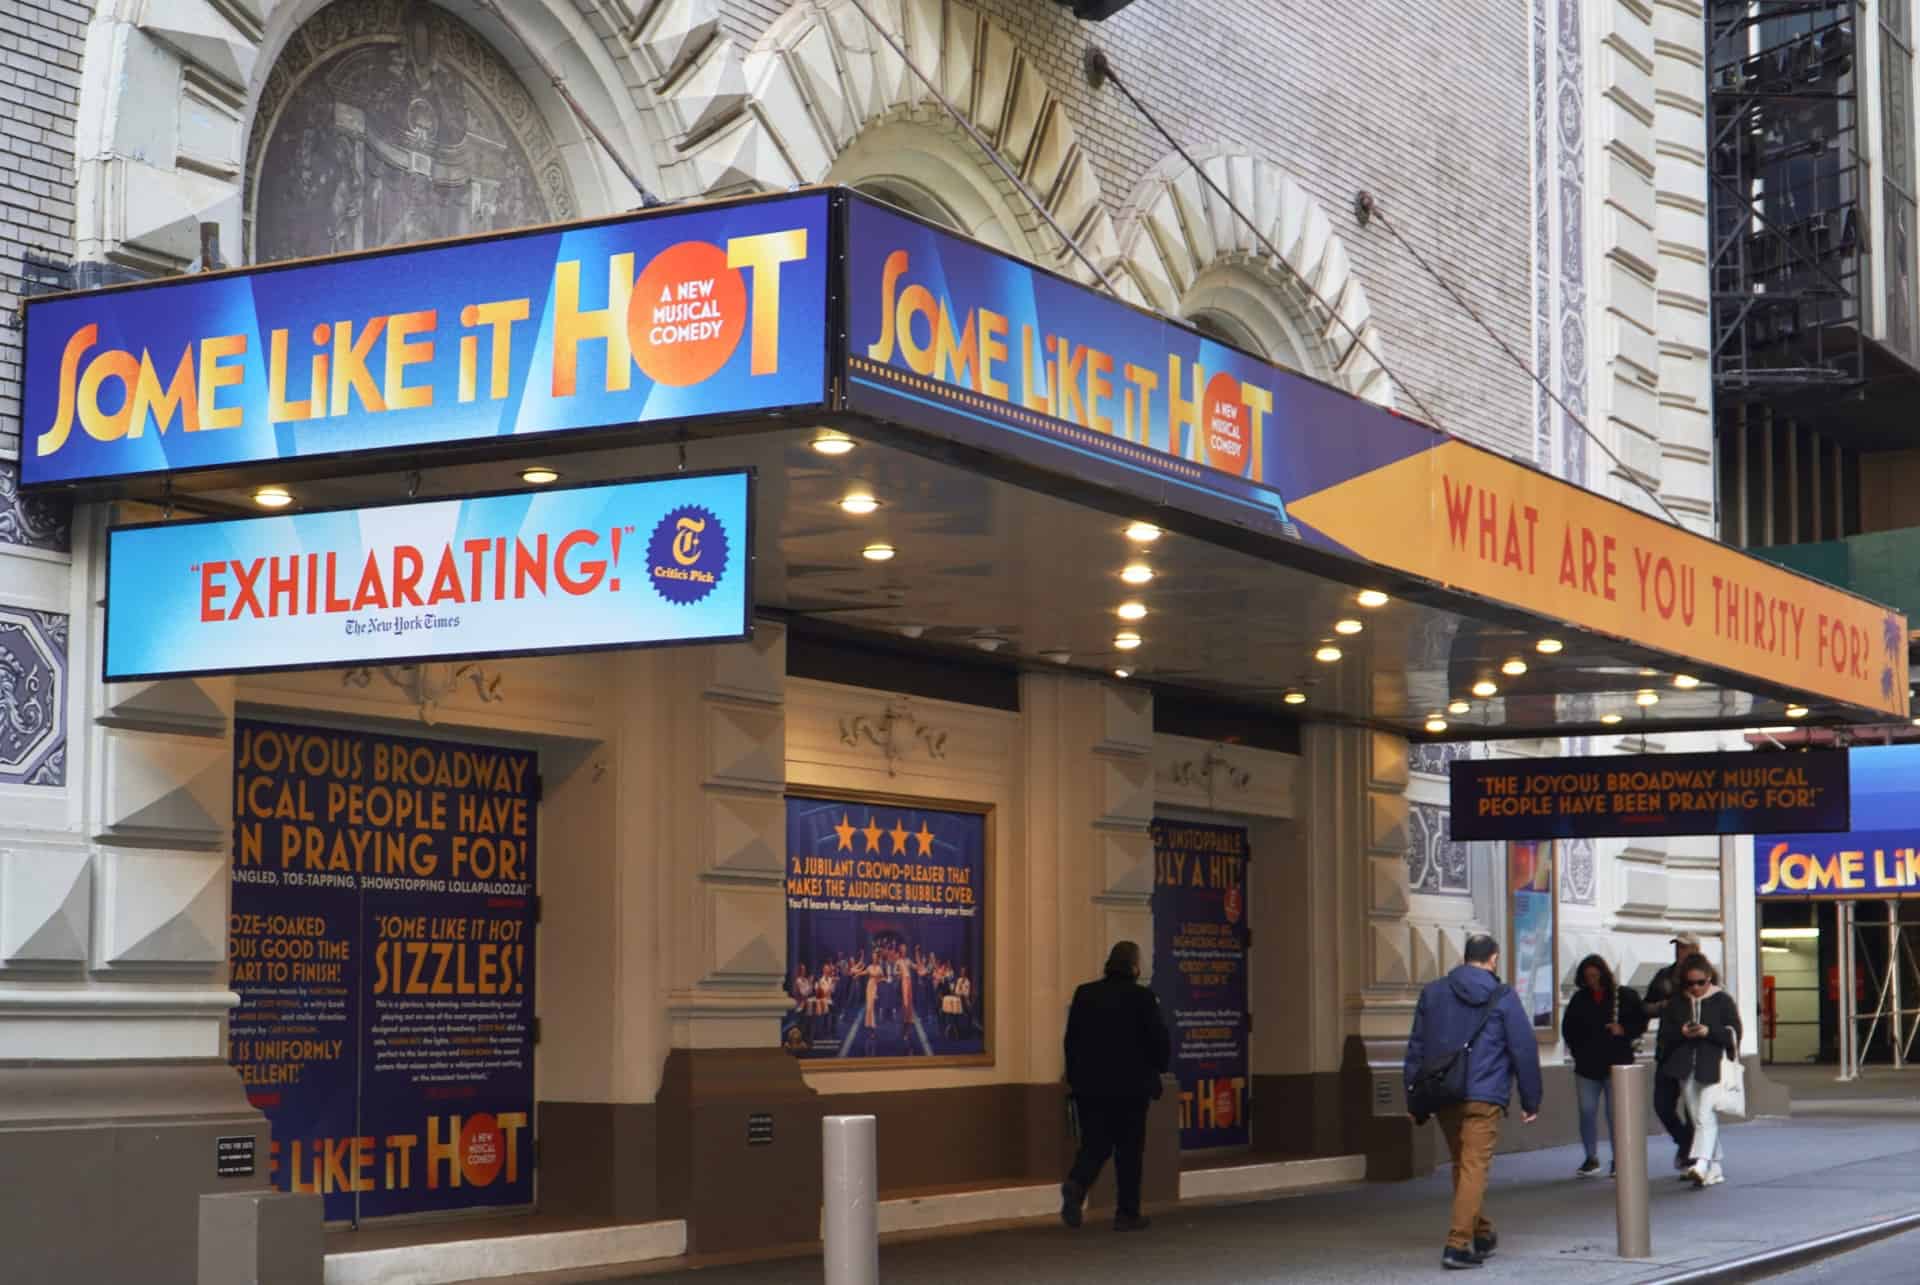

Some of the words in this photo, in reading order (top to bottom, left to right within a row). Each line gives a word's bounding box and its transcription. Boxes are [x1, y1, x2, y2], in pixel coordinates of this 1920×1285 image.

[660, 285, 672, 302] A
[678, 279, 715, 300] NEW
[653, 300, 720, 324] MUSICAL
[37, 323, 247, 456] SOME
[551, 228, 807, 397] HOT
[649, 320, 724, 345] COMEDY
[868, 250, 1008, 400] SOME
[1168, 353, 1273, 482] HOT
[191, 526, 635, 622] "EXHILARATING!"
[689, 569, 714, 584] Pick
[1443, 475, 1538, 574] WHAT
[1559, 521, 1617, 601] ARE
[1634, 547, 1695, 627] YOU
[1712, 575, 1806, 660] THIRSTY
[1818, 614, 1870, 680] FOR?
[345, 619, 366, 635] The
[368, 617, 392, 633] New
[394, 616, 422, 636] York
[424, 613, 460, 630] Times
[240, 728, 363, 781] JOYOUS
[374, 743, 528, 793] BROADWAY
[1523, 774, 1601, 794] JOYOUS
[1606, 770, 1715, 791] BROADWAY
[1723, 767, 1808, 787] MUSICAL
[328, 783, 447, 831] PEOPLE
[459, 793, 528, 837] HAVE
[1479, 797, 1552, 816] PEOPLE
[1559, 795, 1606, 814] HAVE
[1613, 793, 1661, 813] BEEN
[1668, 791, 1760, 811] PRAYING
[281, 826, 439, 877] PRAYING
[452, 835, 528, 881] FOR!
[804, 856, 854, 877] JUBILANT
[857, 861, 945, 883] CROWD-PLEASER
[947, 866, 970, 884] THAT
[1192, 855, 1204, 888] A
[1760, 842, 1865, 894] SOME
[361, 877, 445, 893] SHOWSTOPPING
[787, 878, 822, 896] MAKES
[826, 879, 845, 897] THE
[848, 880, 902, 900] AUDIENCE
[905, 883, 942, 902] BUBBLE
[432, 917, 466, 939] LIKE
[471, 918, 485, 940] IT
[489, 919, 523, 941] HOT
[262, 939, 314, 960] GOOD
[318, 941, 349, 961] TIME
[267, 962, 288, 982] TO
[293, 963, 341, 983] FINISH!
[373, 940, 524, 995] SIZZLES!
[240, 1040, 250, 1061] IS
[254, 1040, 343, 1062] UNIFORMLY
[1198, 1077, 1246, 1128] HOT
[427, 1112, 528, 1190] HOT
